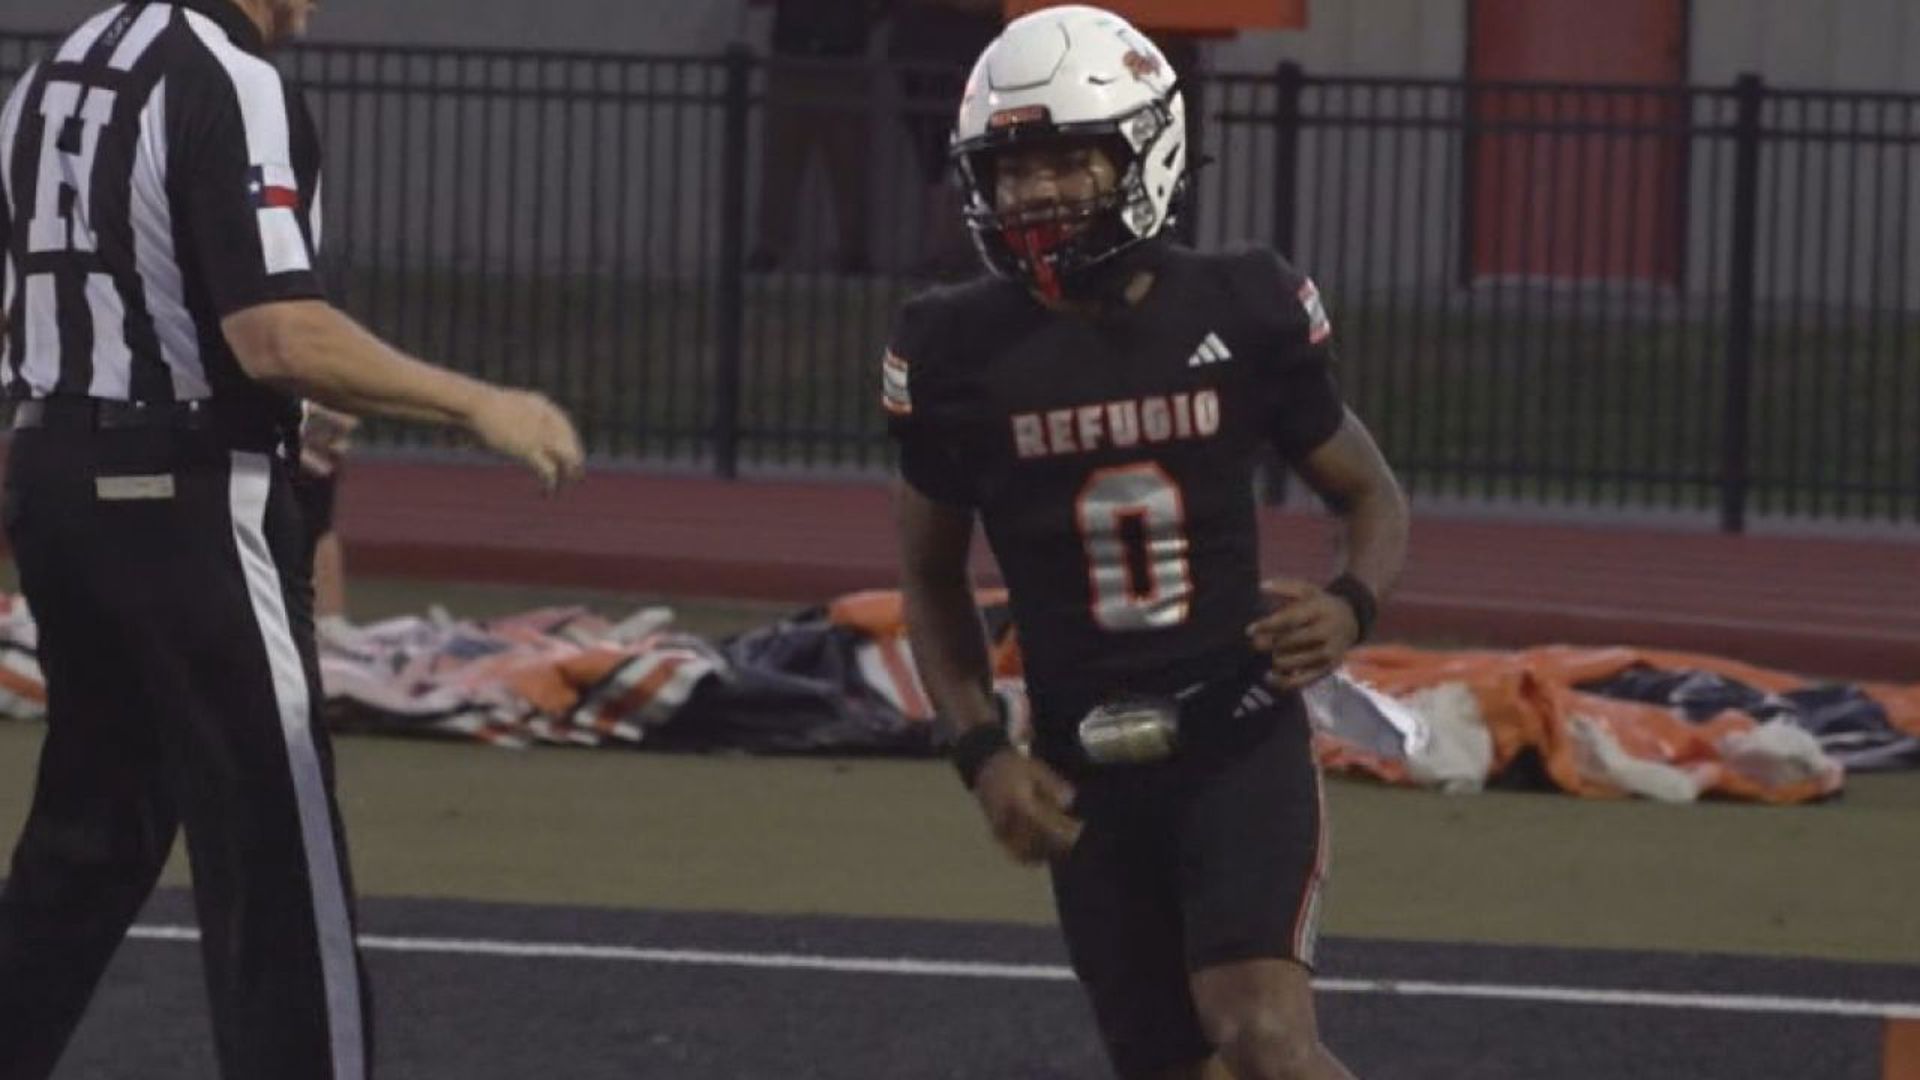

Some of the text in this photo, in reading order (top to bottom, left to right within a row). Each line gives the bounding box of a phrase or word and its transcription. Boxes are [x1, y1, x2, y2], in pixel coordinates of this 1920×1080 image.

[27, 80, 118, 253] H
[1011, 389, 1221, 459] REFUGIO
[1076, 460, 1194, 632] 0
